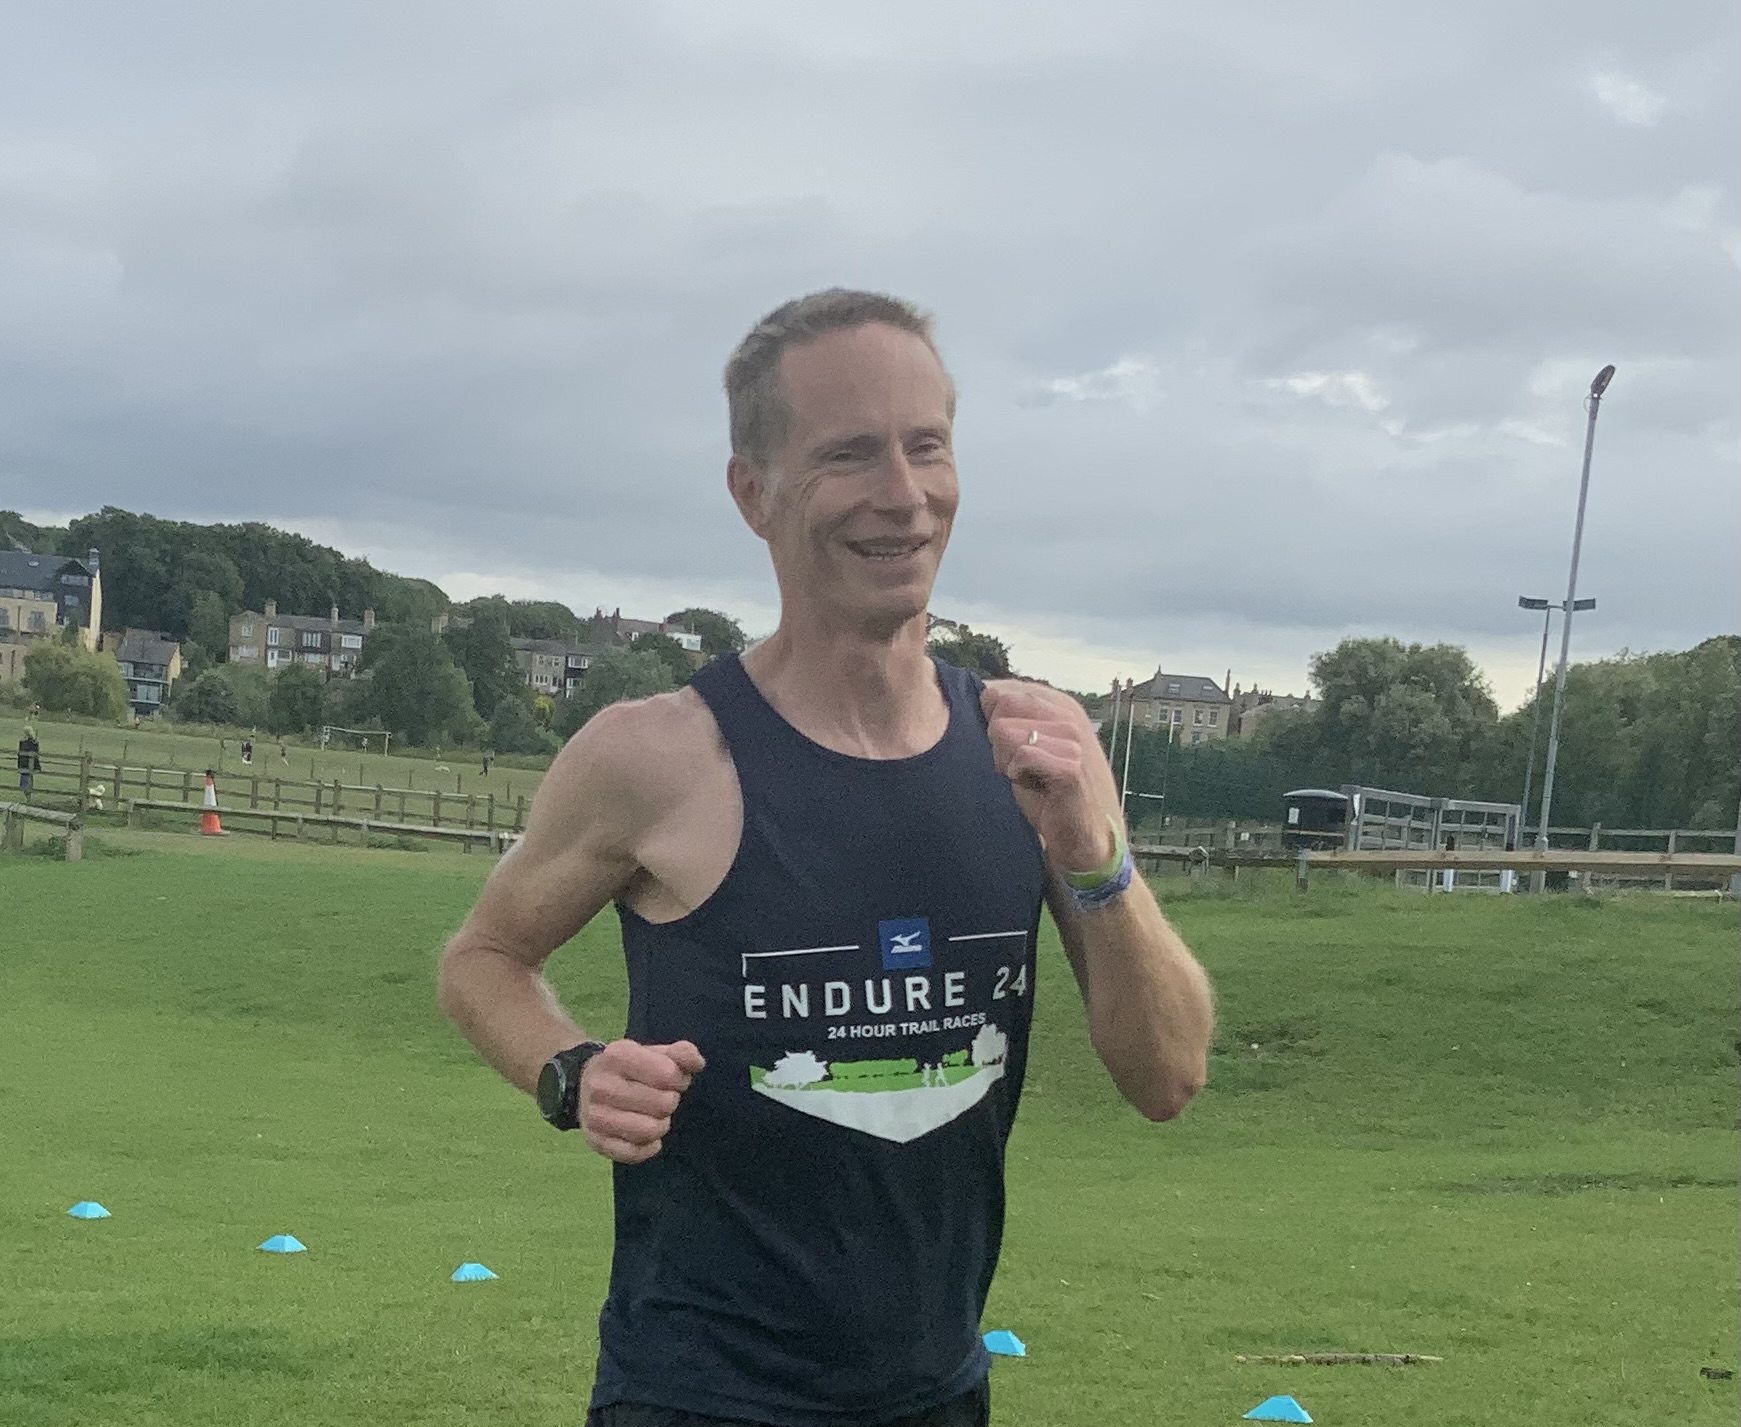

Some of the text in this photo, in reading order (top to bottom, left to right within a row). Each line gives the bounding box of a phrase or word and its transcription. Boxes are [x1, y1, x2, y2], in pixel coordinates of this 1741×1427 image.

[744, 963, 1027, 1020] ENDURE 24
[828, 1012, 986, 1039] 24 HOUR TRAIL RACES
